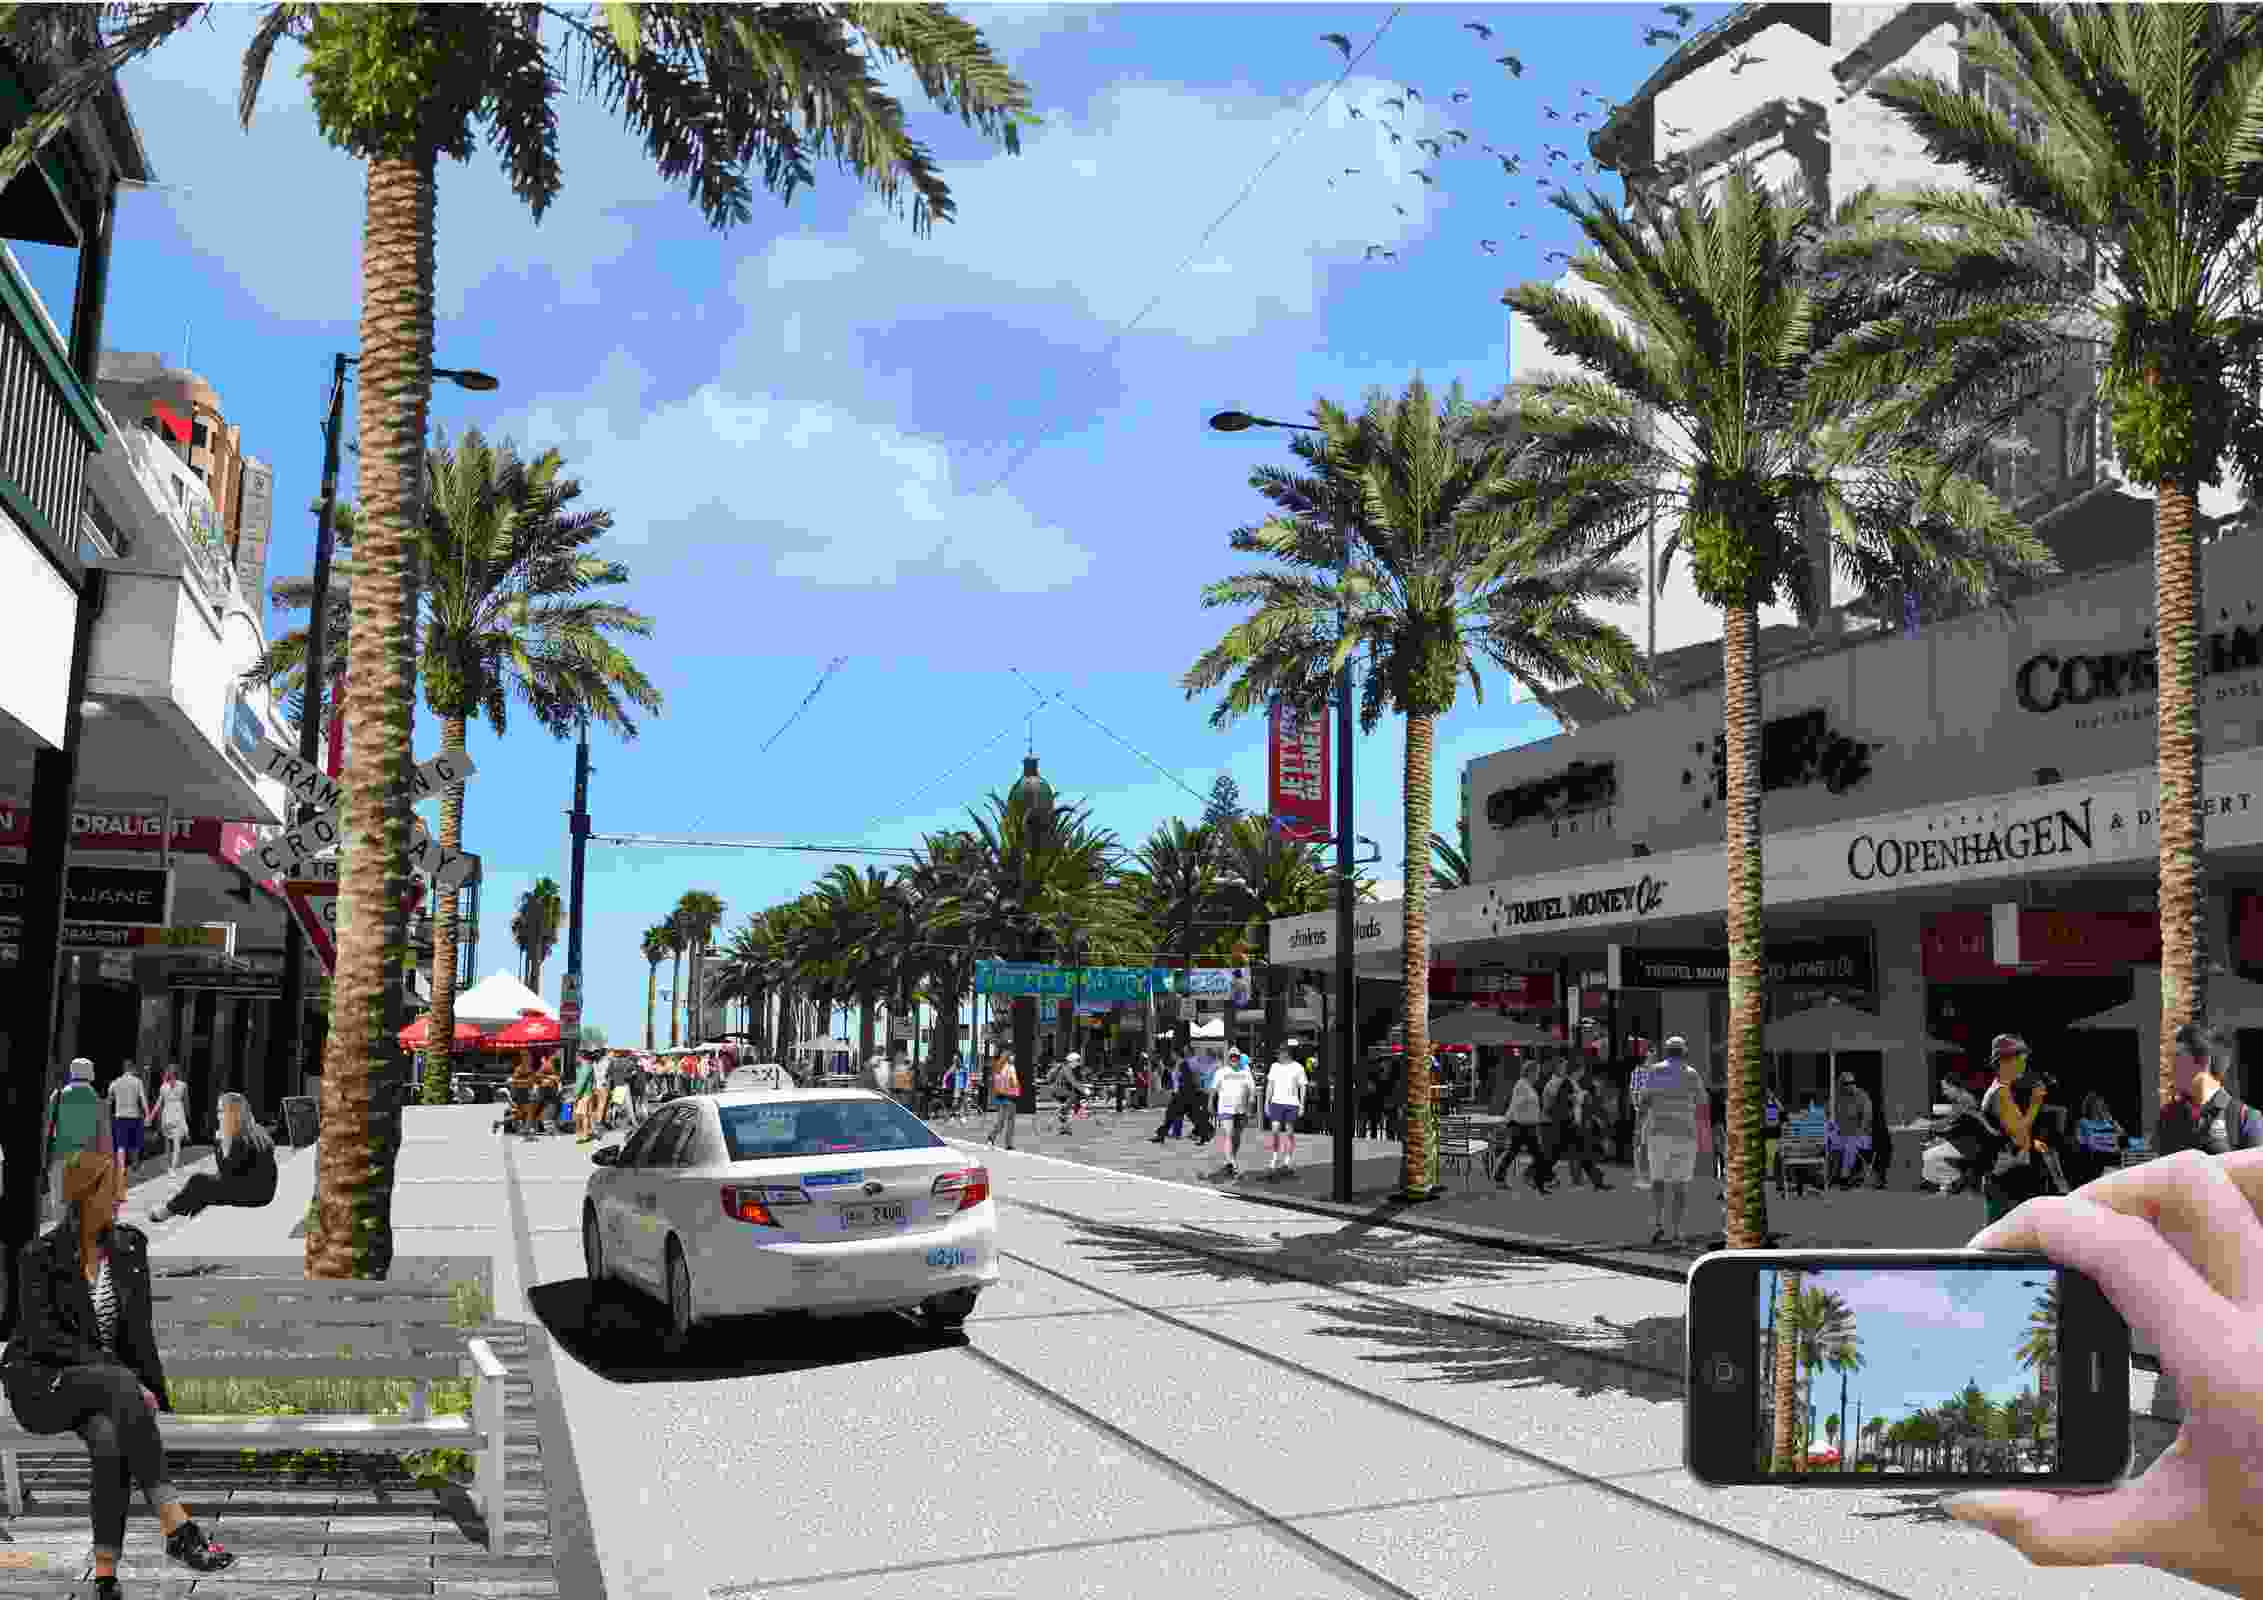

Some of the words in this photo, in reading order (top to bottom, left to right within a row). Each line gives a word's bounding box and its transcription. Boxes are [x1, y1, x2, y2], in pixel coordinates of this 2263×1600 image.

[1848, 799, 2093, 880] COPENHAGEN
[1503, 896, 1566, 927] TRAVEL
[1568, 887, 1636, 918] MONEY
